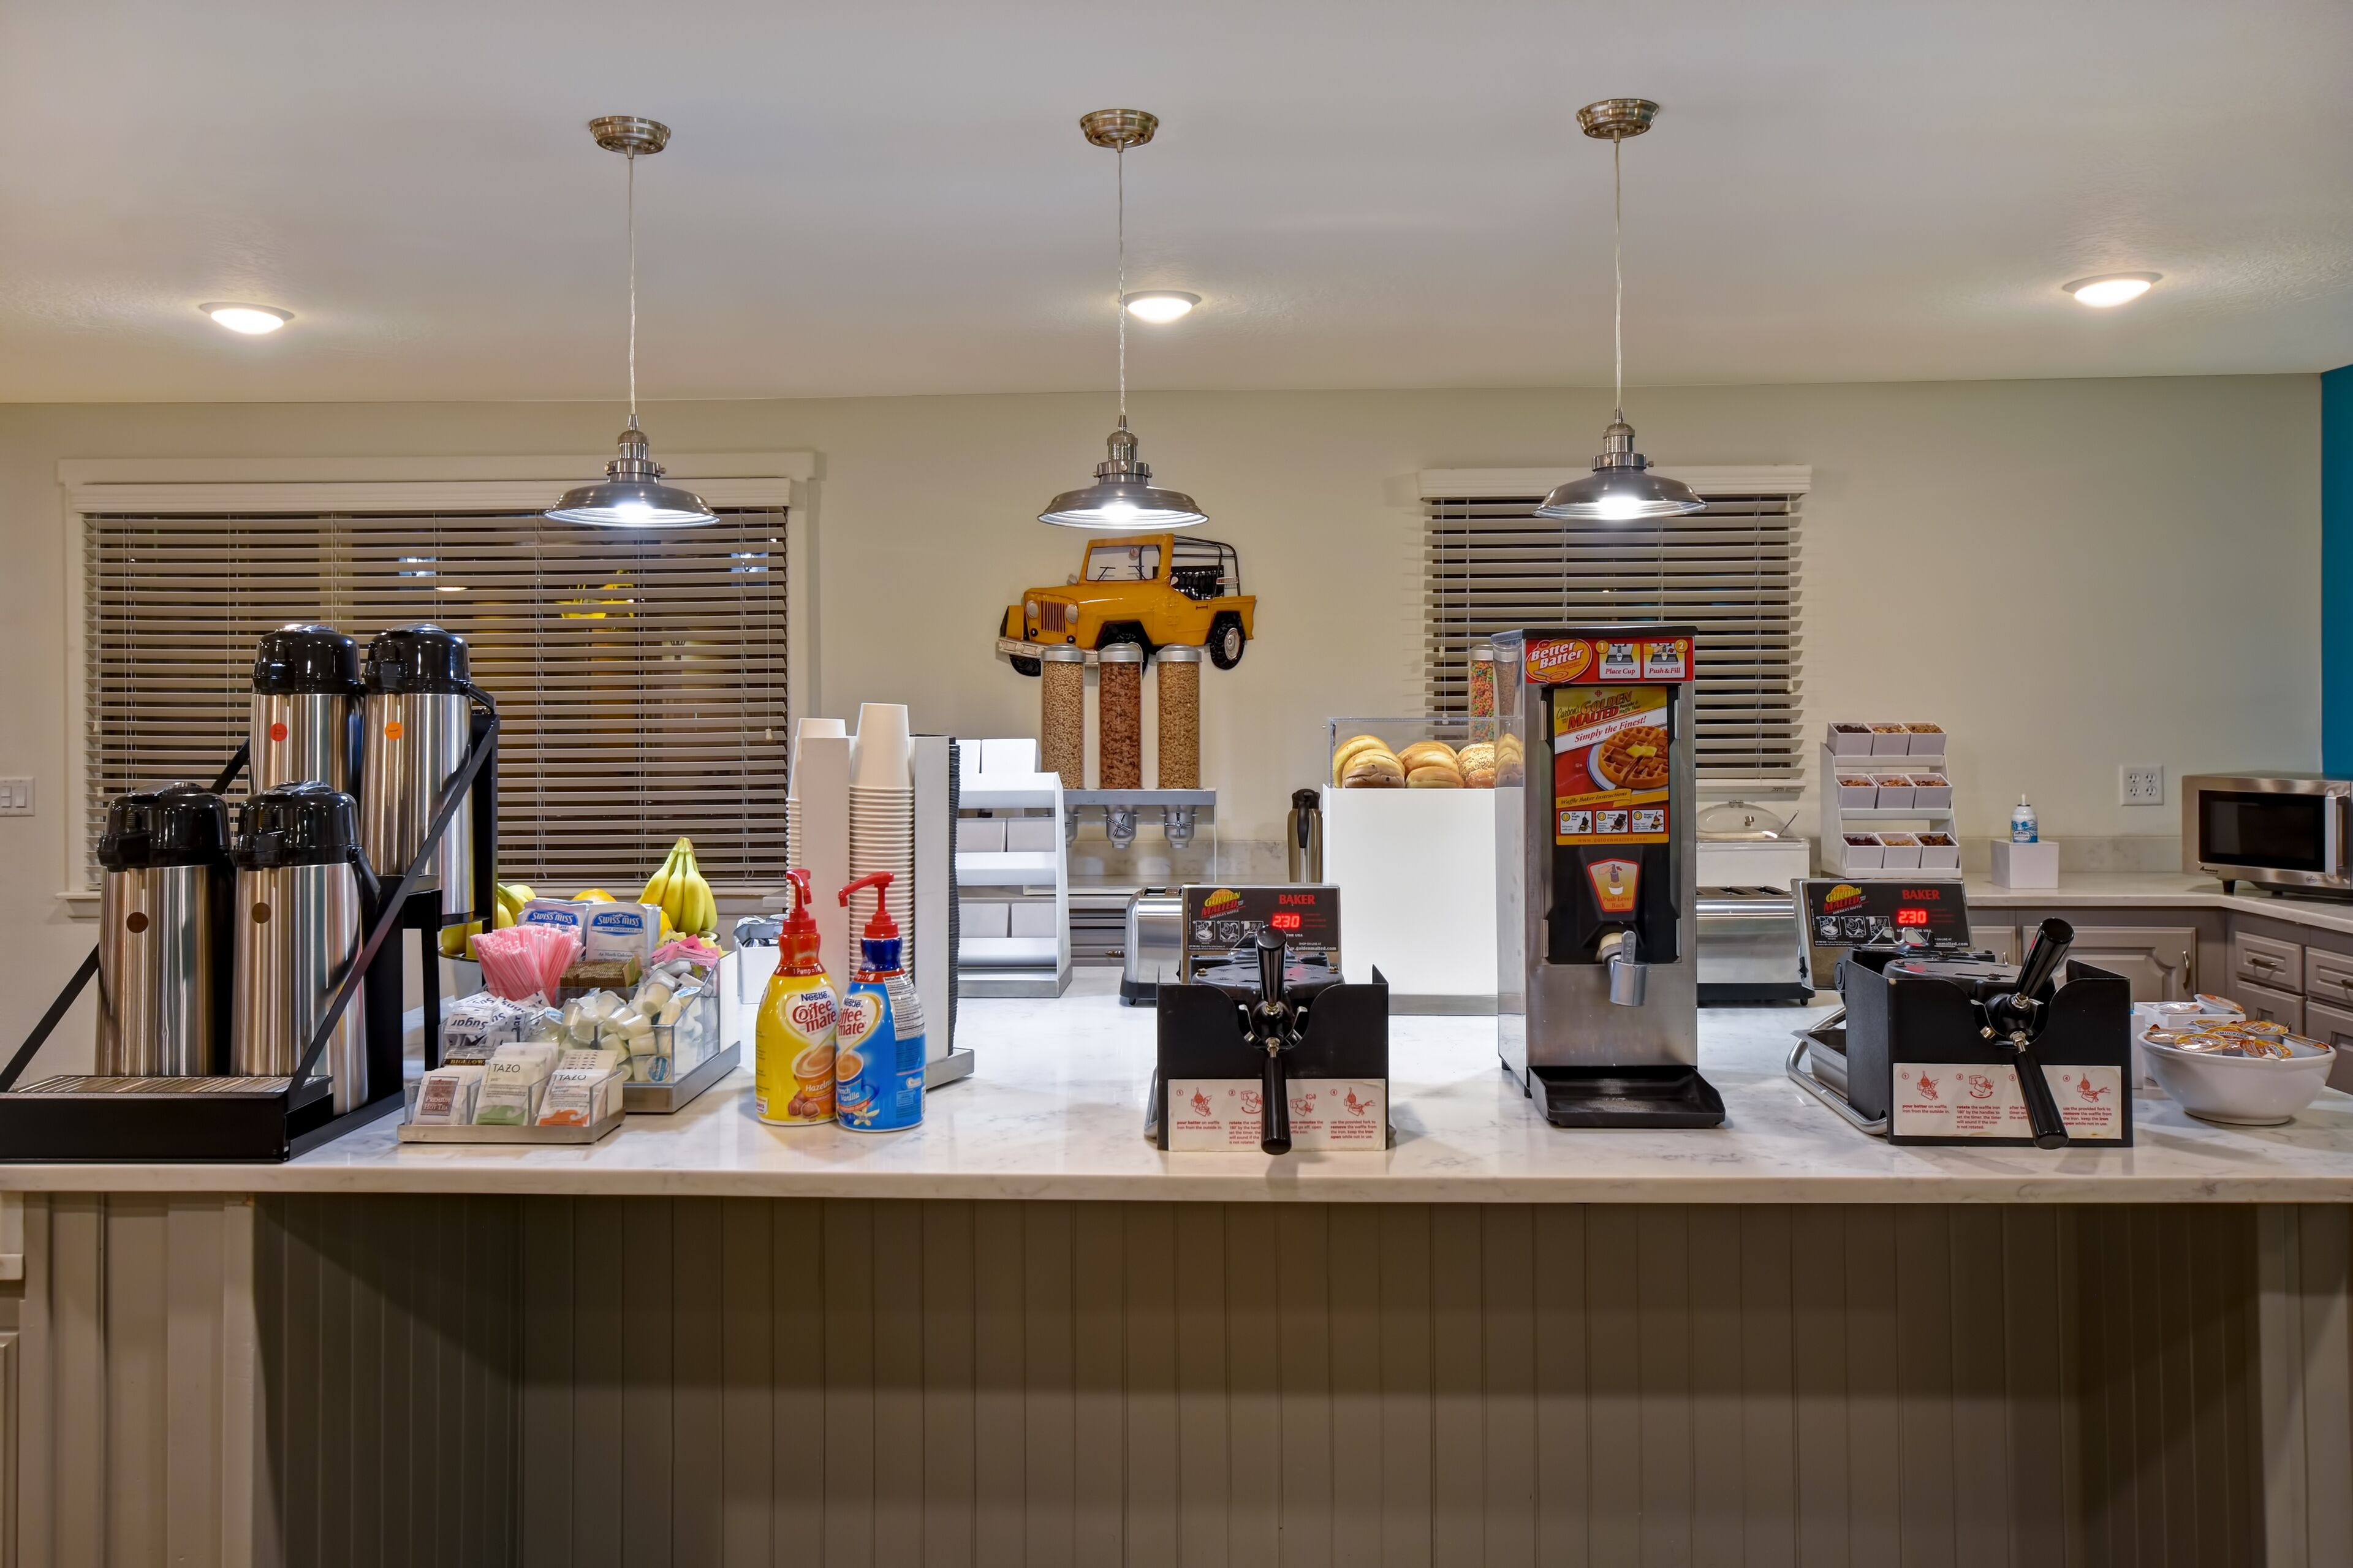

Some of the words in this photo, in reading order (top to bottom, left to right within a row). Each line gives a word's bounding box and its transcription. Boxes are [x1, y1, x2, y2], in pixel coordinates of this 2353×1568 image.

[1531, 642, 1575, 661] Better
[1600, 642, 1604, 650] 1
[1539, 648, 1583, 669] Batter
[1580, 691, 1632, 714] GOLDEN
[1567, 705, 1620, 729] MALTED
[1574, 729, 1603, 743] Simply
[1605, 724, 1618, 734] the
[1620, 716, 1647, 730] Finest!
[1596, 791, 1627, 800] Instructions
[1204, 892, 1241, 907] GOLDEN
[1279, 894, 1315, 905] BAKER
[1826, 887, 1862, 903] GOLDEN
[1902, 889, 1940, 900] BAKER
[1201, 900, 1238, 916] MALTED
[1824, 896, 1860, 912] MALTED
[451, 1017, 488, 1030] Sugar
[805, 1010, 836, 1032] mate
[493, 1064, 520, 1072] TAZO
[840, 1092, 860, 1102] Vanilla
